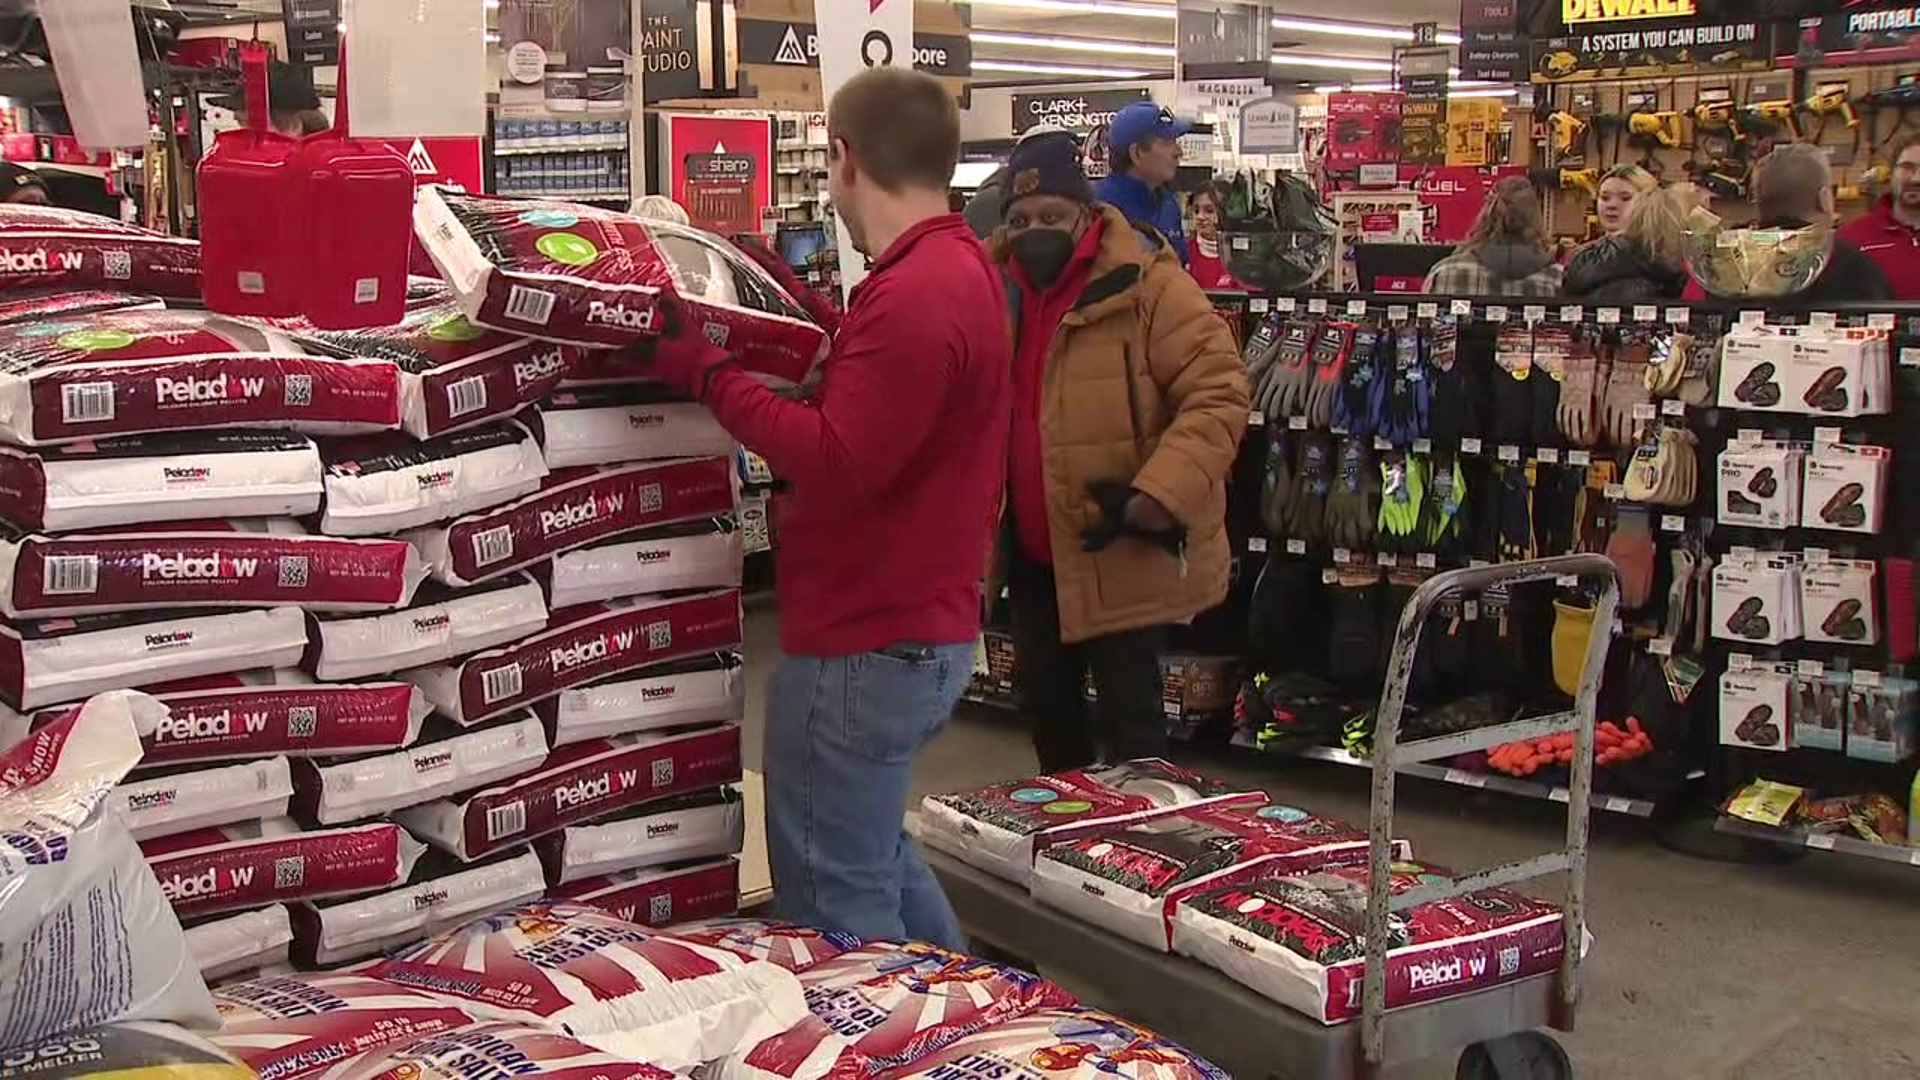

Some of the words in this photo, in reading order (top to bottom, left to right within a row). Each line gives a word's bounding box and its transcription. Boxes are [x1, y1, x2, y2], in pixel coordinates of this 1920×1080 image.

[648, 16, 668, 26] THE
[1484, 6, 1509, 17] TOOLS
[1849, 8, 1920, 32] PORTABLE
[640, 28, 683, 49] AINT
[1418, 26, 1433, 41] 18
[1582, 37, 1590, 52] A
[1592, 33, 1640, 51] SYSTEM
[1642, 31, 1666, 48] YOU
[1668, 28, 1693, 46] CAN
[1697, 25, 1734, 44] BUILD
[1737, 24, 1755, 40] ON
[640, 50, 691, 72] TUDIO
[1198, 84, 1254, 95] MAGNOLIA
[1039, 111, 1118, 127] KENSINGTO
[161, 866, 255, 900] eladow
[23, 1051, 103, 1073] MELTER
